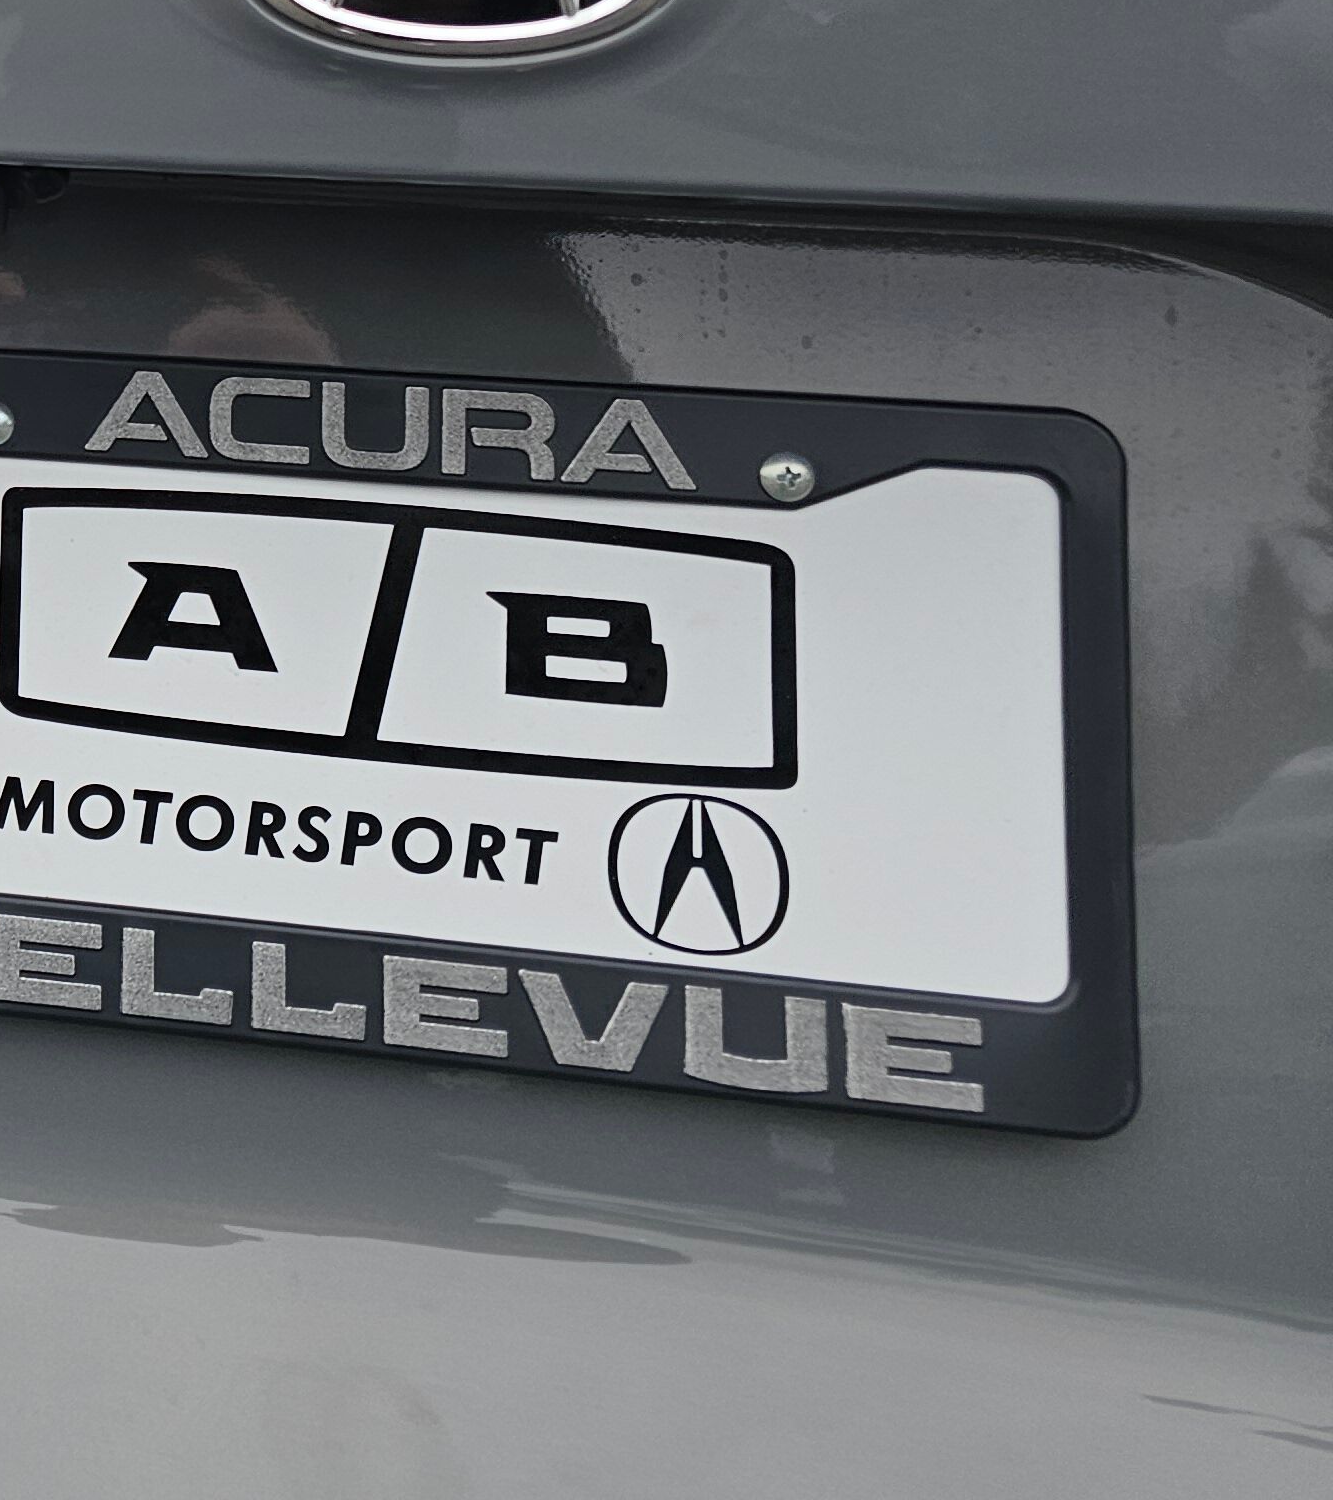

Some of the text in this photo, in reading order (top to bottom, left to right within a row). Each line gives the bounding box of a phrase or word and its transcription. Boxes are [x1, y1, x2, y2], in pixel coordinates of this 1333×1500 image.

[83, 369, 698, 491] ACURA
[107, 560, 669, 709] A B
